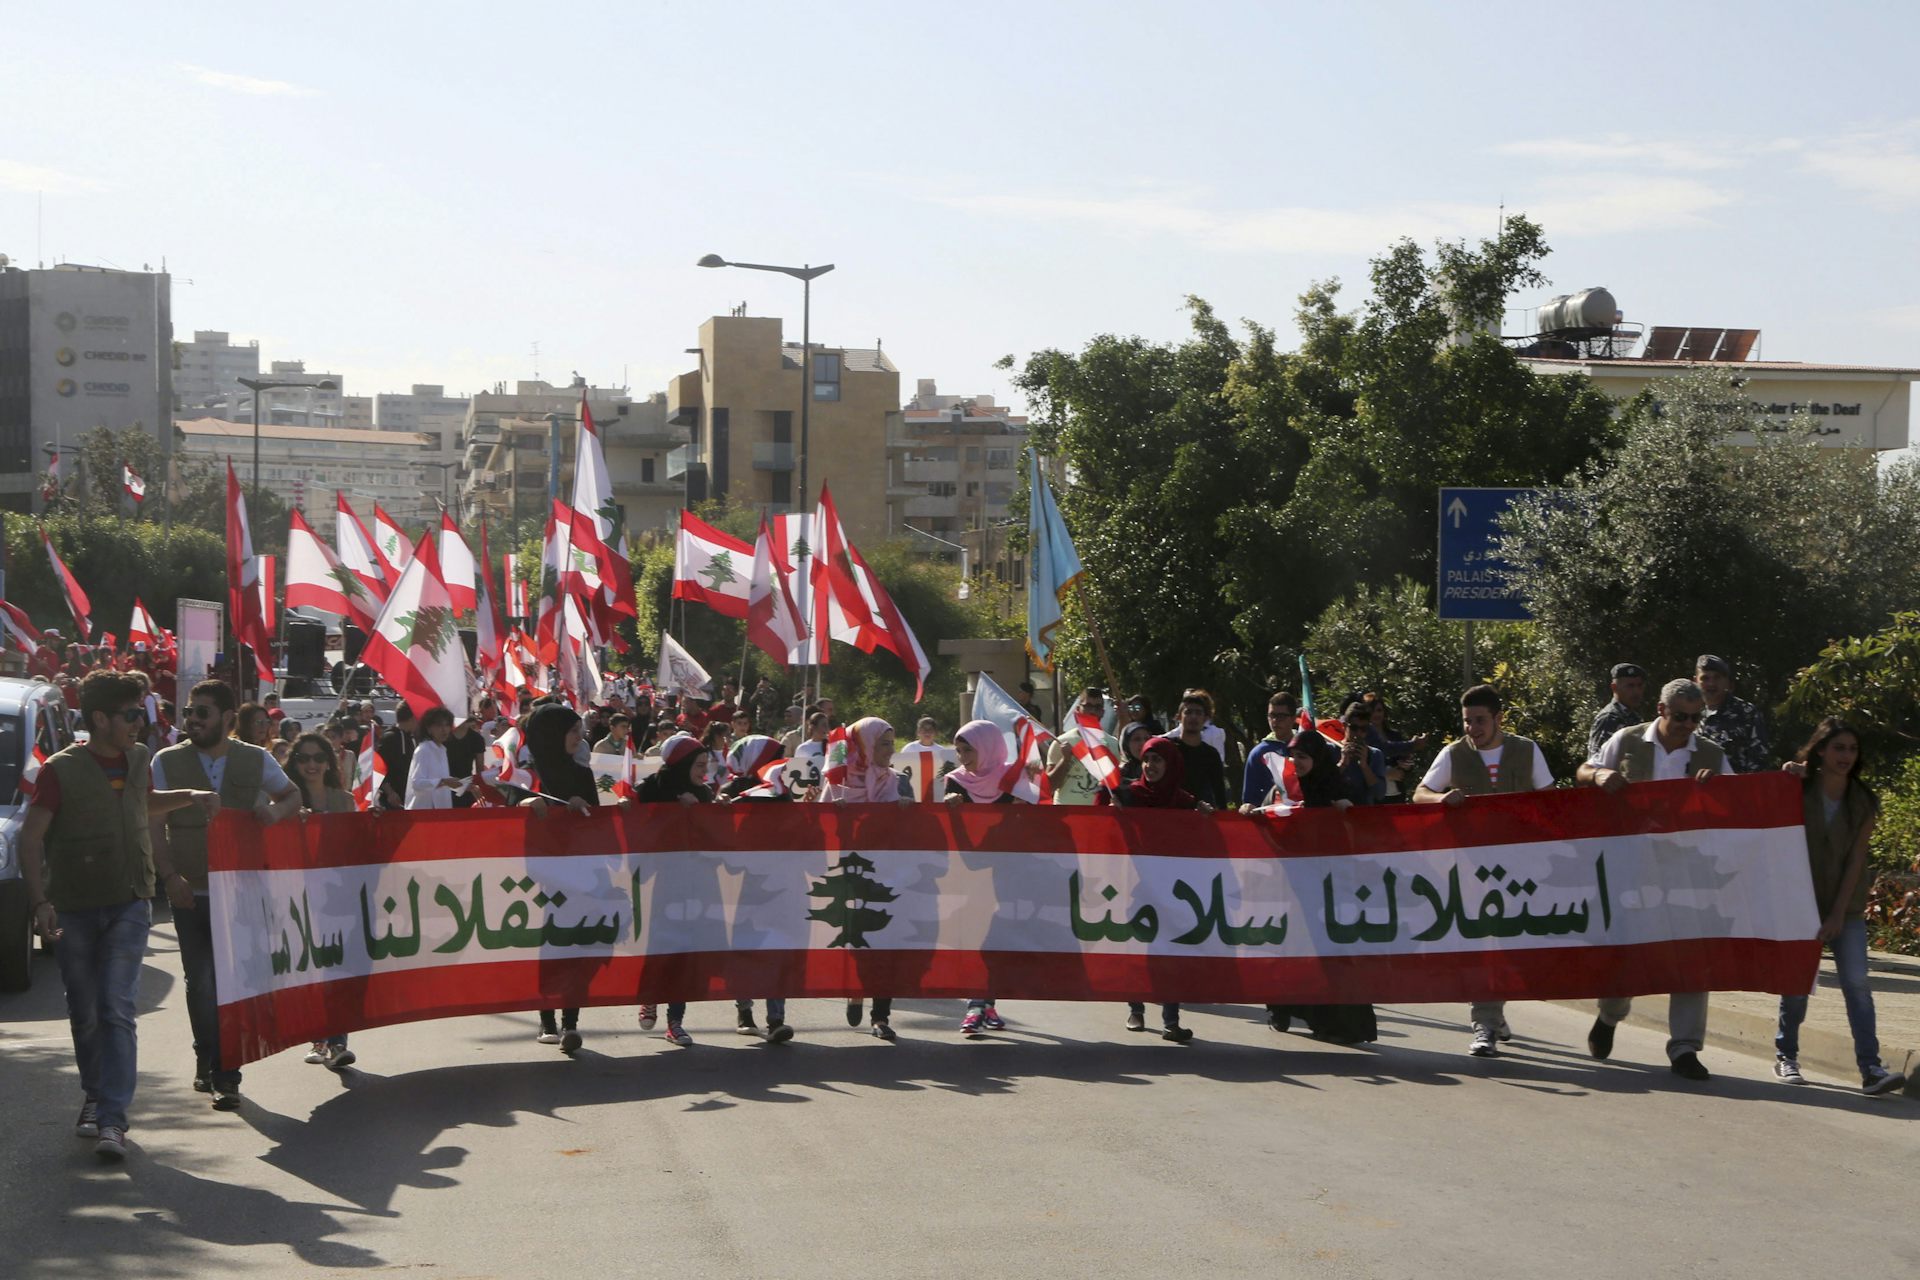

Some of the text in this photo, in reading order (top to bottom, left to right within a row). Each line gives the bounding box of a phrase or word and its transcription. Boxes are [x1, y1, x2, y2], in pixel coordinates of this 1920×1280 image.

[1811, 402, 1829, 415] the
[1833, 403, 1861, 415] Deaf
[1447, 570, 1494, 583] PALAIS
[262, 866, 641, 976] استقلالنا سلام
[1069, 850, 1611, 946] استقلالنا سلامنا
